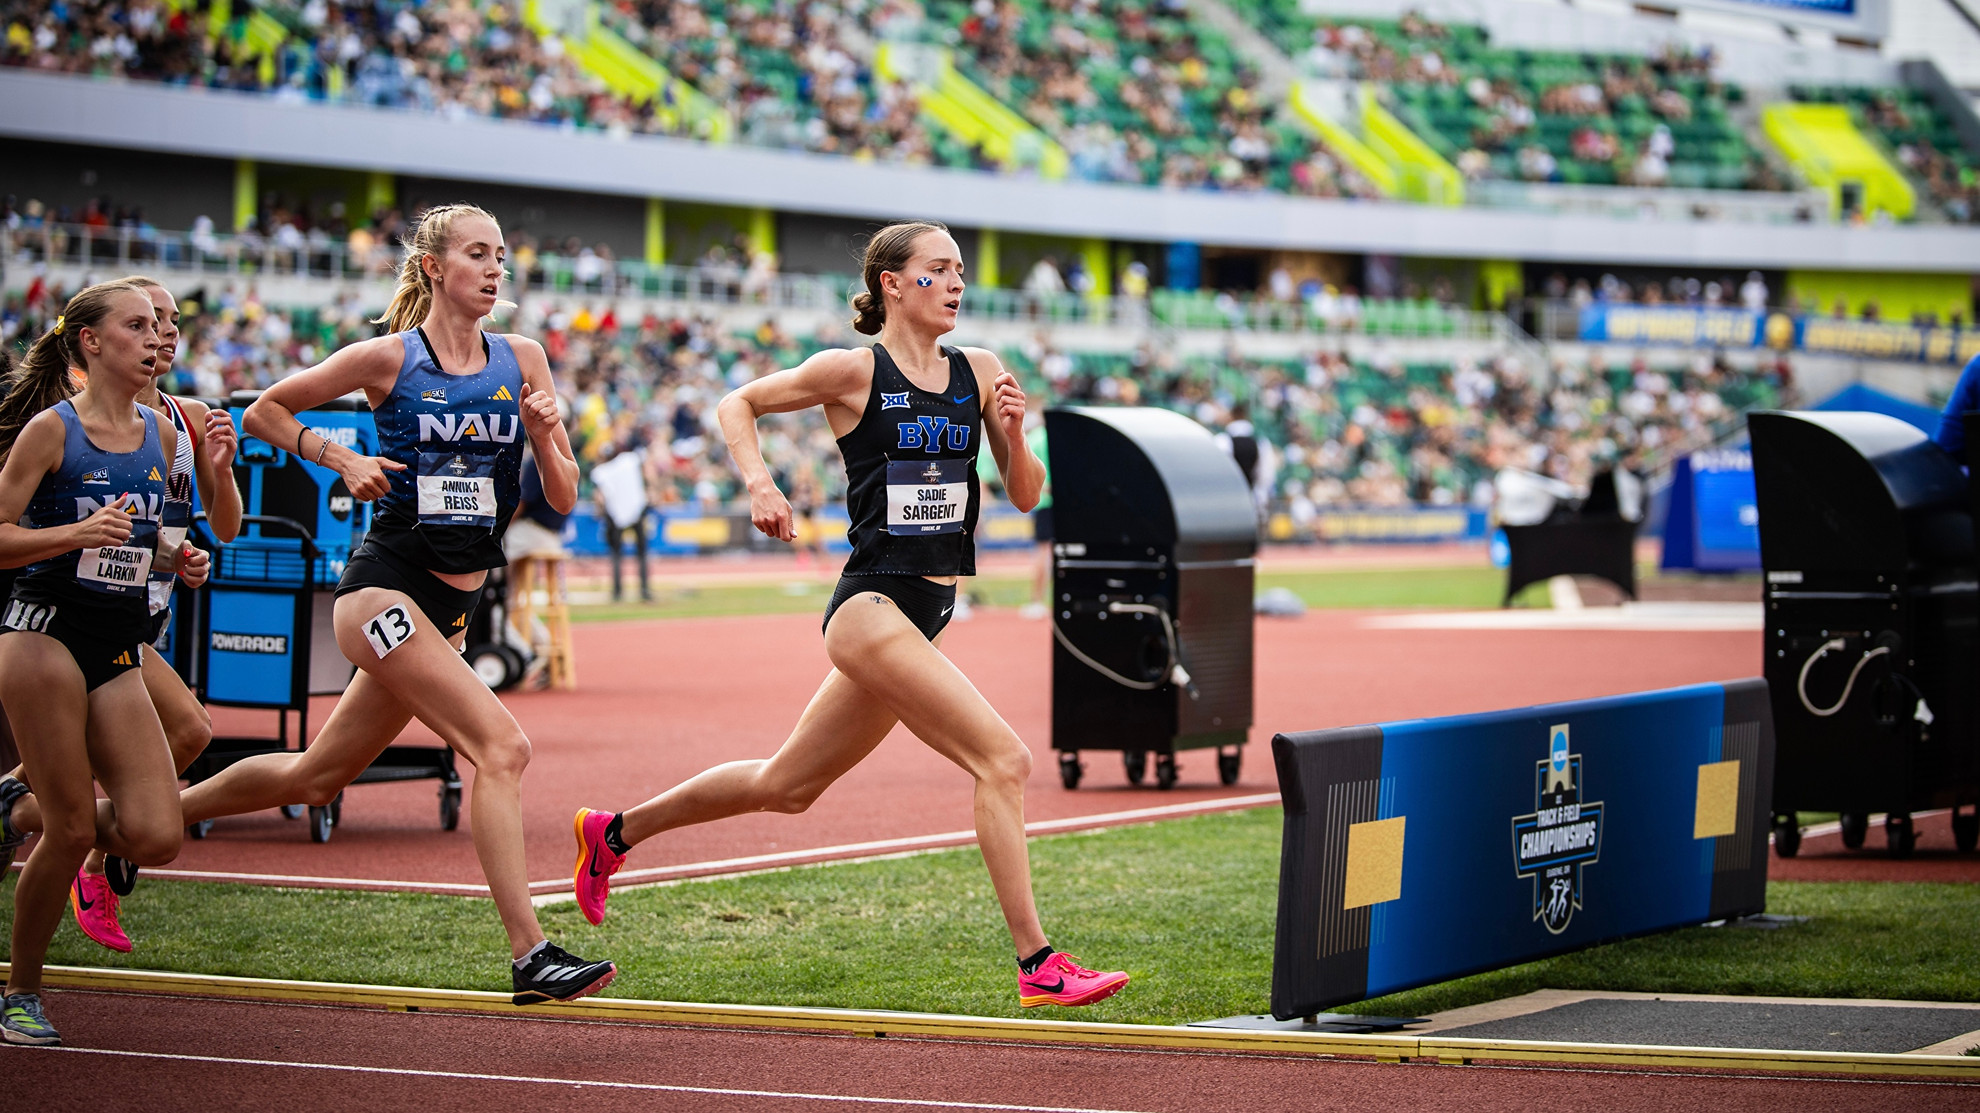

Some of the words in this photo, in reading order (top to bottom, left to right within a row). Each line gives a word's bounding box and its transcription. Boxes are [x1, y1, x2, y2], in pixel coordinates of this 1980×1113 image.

[416, 413, 518, 443] NAU
[898, 416, 970, 453] BYU
[441, 480, 480, 493] ANNIKA
[917, 488, 947, 501] SADIE
[444, 495, 479, 511] REISS
[903, 503, 957, 520] SARGENT
[99, 547, 143, 564] GRACELYN
[97, 562, 137, 582] LARKIN
[370, 608, 411, 650] 13
[212, 632, 286, 653] POWERADE
[1537, 807, 1558, 828] TRACK
[1563, 803, 1580, 823] FIELD
[1520, 821, 1597, 859] CHAMPIONSHIPS
